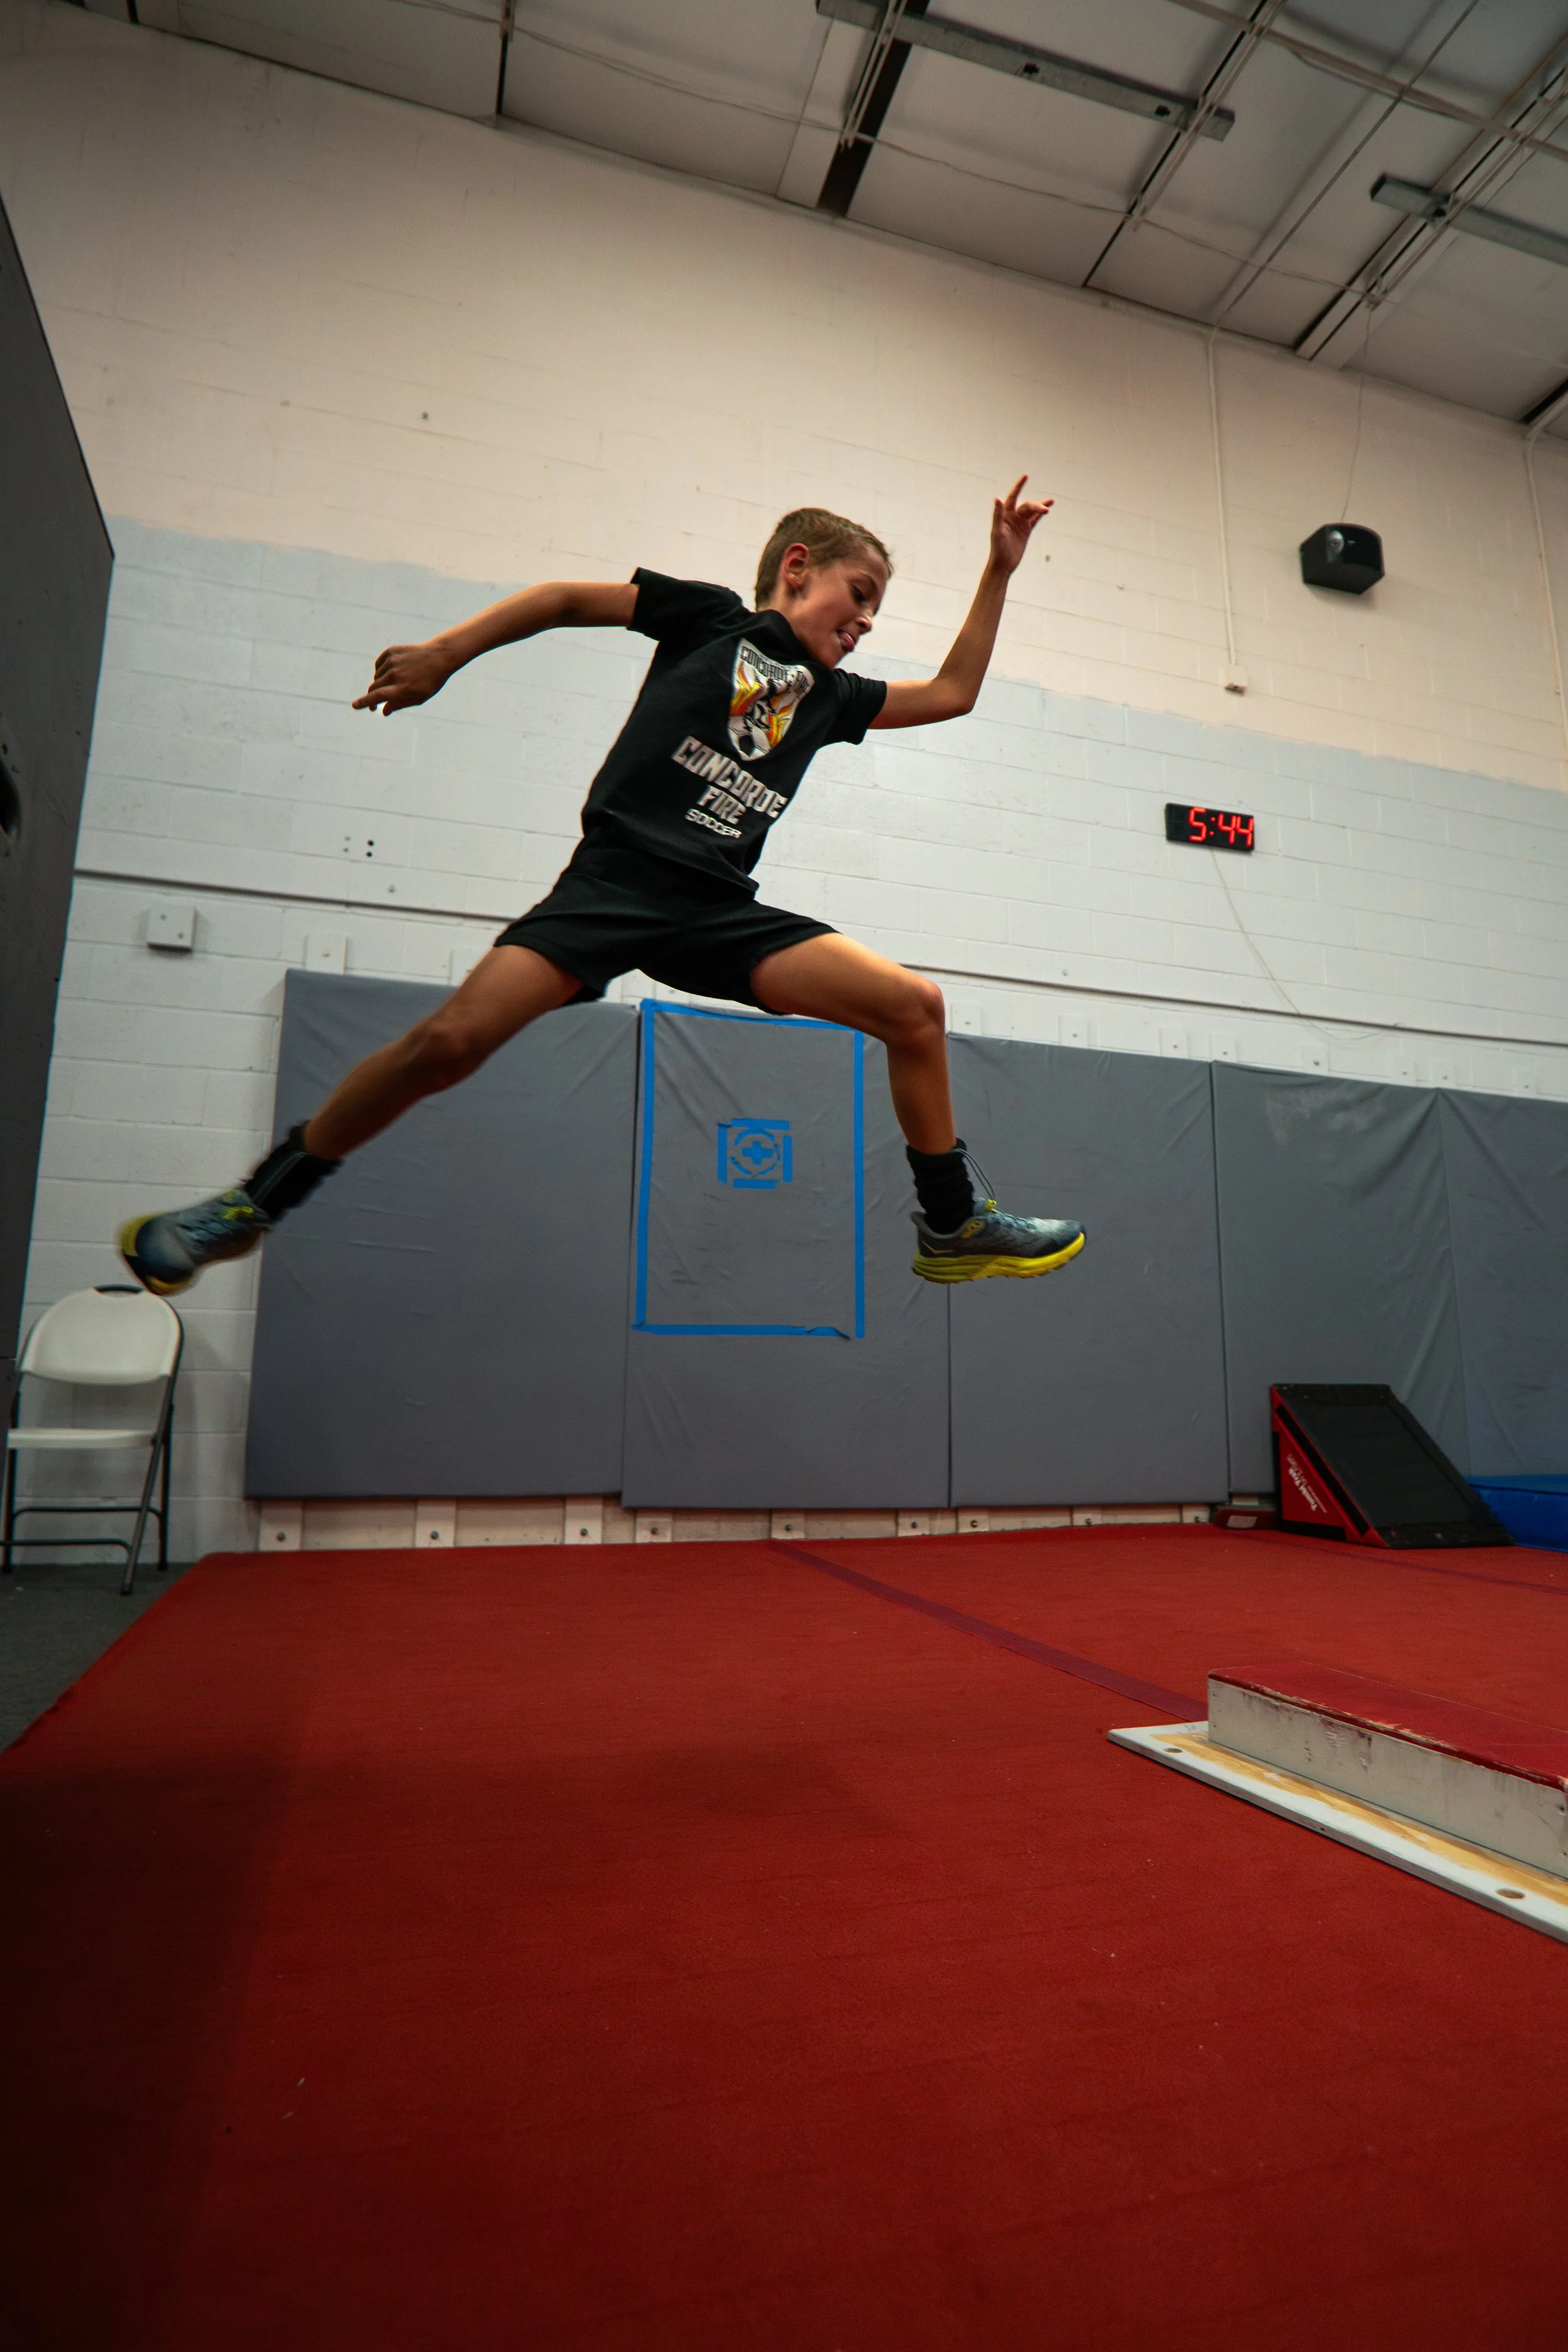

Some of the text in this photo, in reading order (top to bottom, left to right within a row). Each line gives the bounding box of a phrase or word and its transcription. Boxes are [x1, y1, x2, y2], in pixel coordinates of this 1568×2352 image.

[671, 735, 788, 818] CONCORDE
[685, 808, 743, 839] SOCCER
[697, 785, 746, 825] FIRE
[1189, 807, 1254, 847] 5:44
